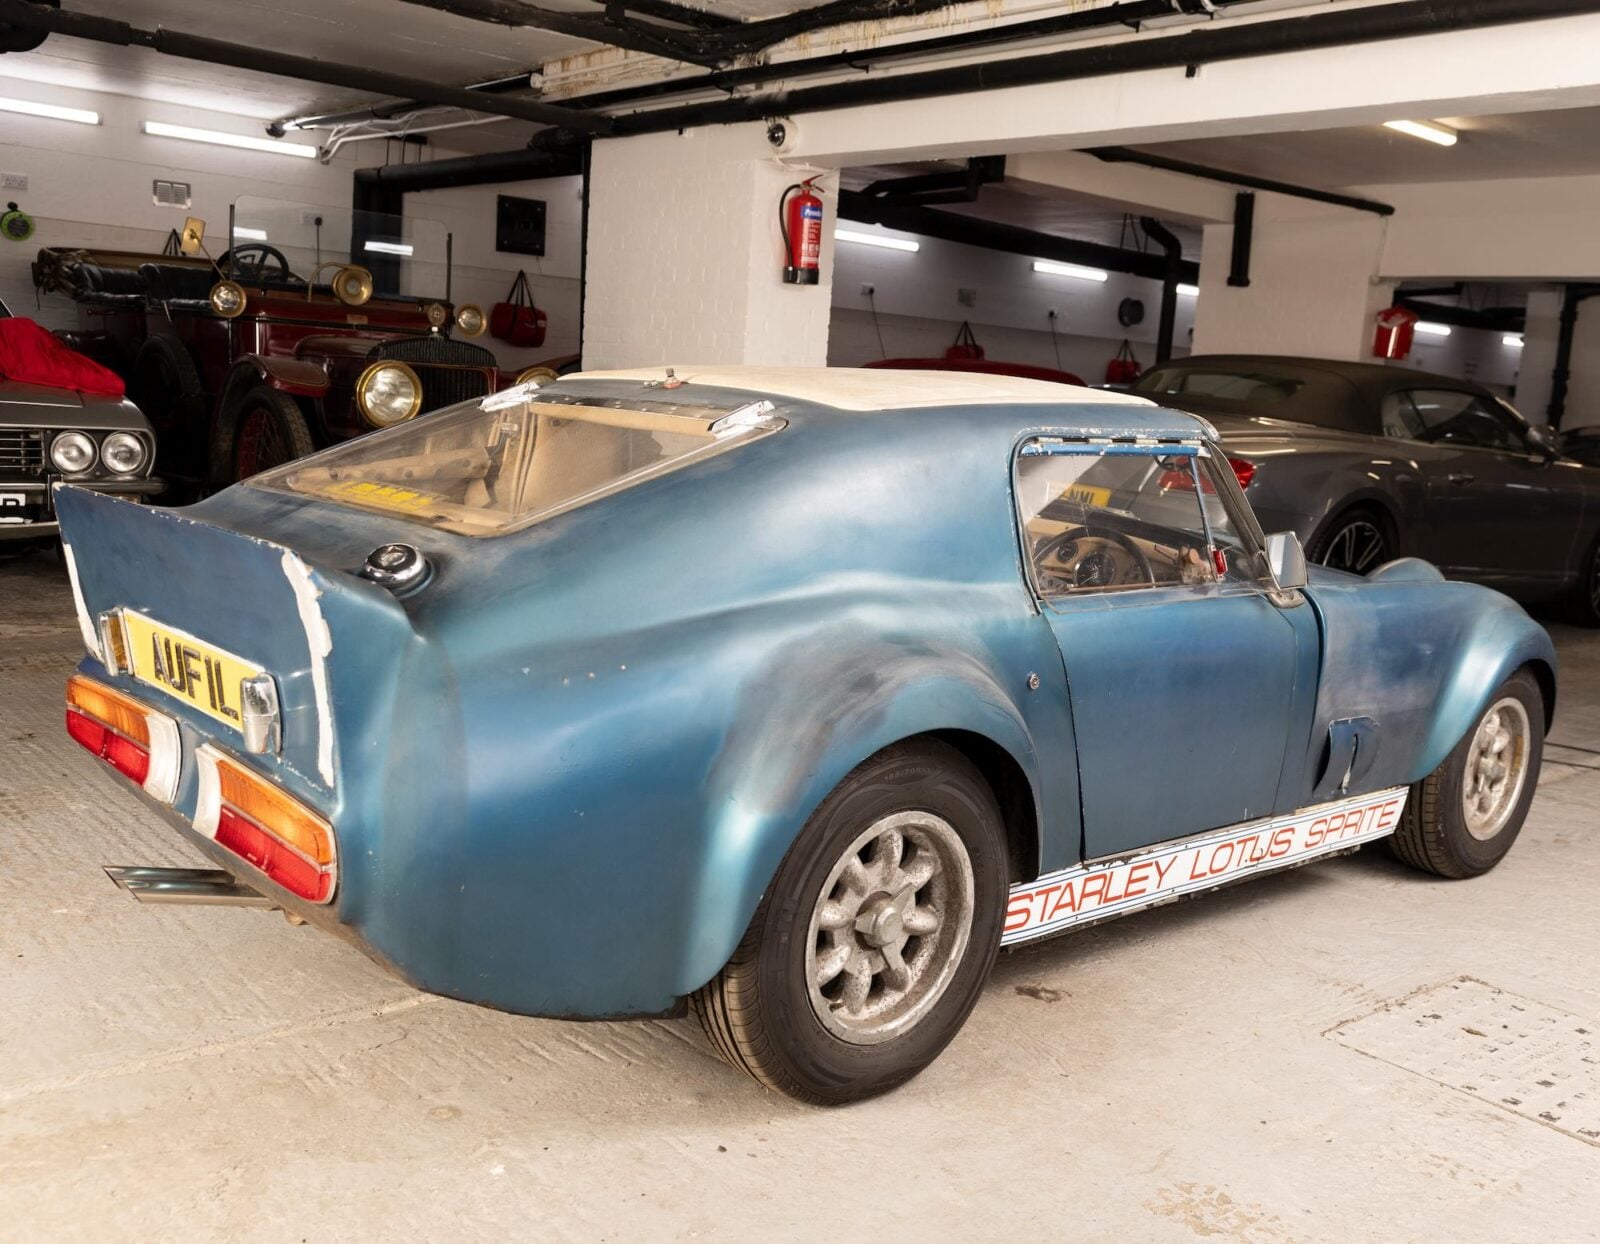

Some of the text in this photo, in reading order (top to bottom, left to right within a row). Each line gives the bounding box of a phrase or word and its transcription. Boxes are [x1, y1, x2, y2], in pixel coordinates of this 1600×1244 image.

[1003, 859, 1177, 932] STARLEY
[1189, 827, 1295, 880] LOTUS
[1304, 800, 1399, 848] SPRITE
